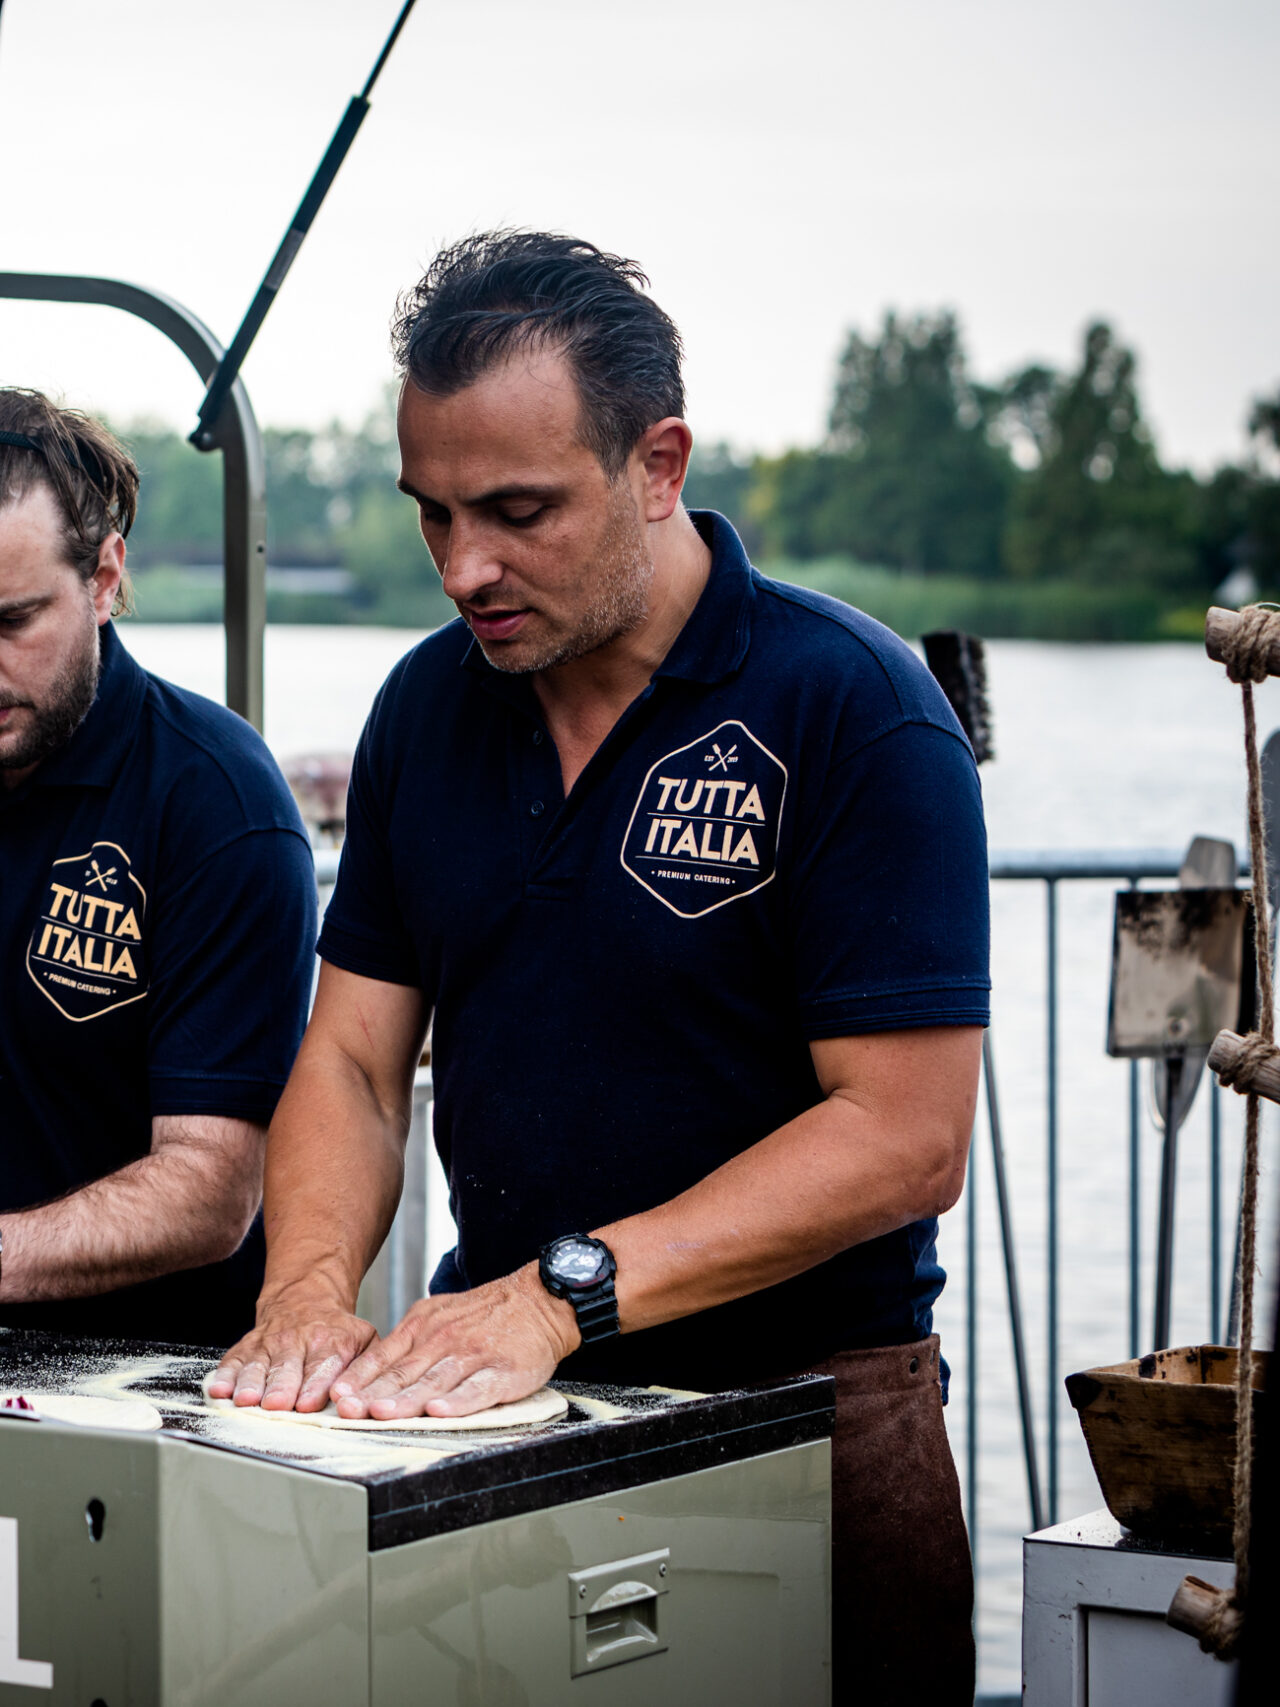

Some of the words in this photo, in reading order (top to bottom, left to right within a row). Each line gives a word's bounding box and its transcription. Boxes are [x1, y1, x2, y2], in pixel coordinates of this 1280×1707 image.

[657, 776, 765, 821] TUTTA
[644, 818, 760, 865] ITALIA
[657, 870, 691, 880] PREMIUM
[694, 874, 730, 885] CATERING
[49, 882, 142, 940] TUTTA
[37, 923, 138, 979] ITALIA
[48, 973, 77, 988] PREMIUM
[77, 982, 111, 995] CATERING
